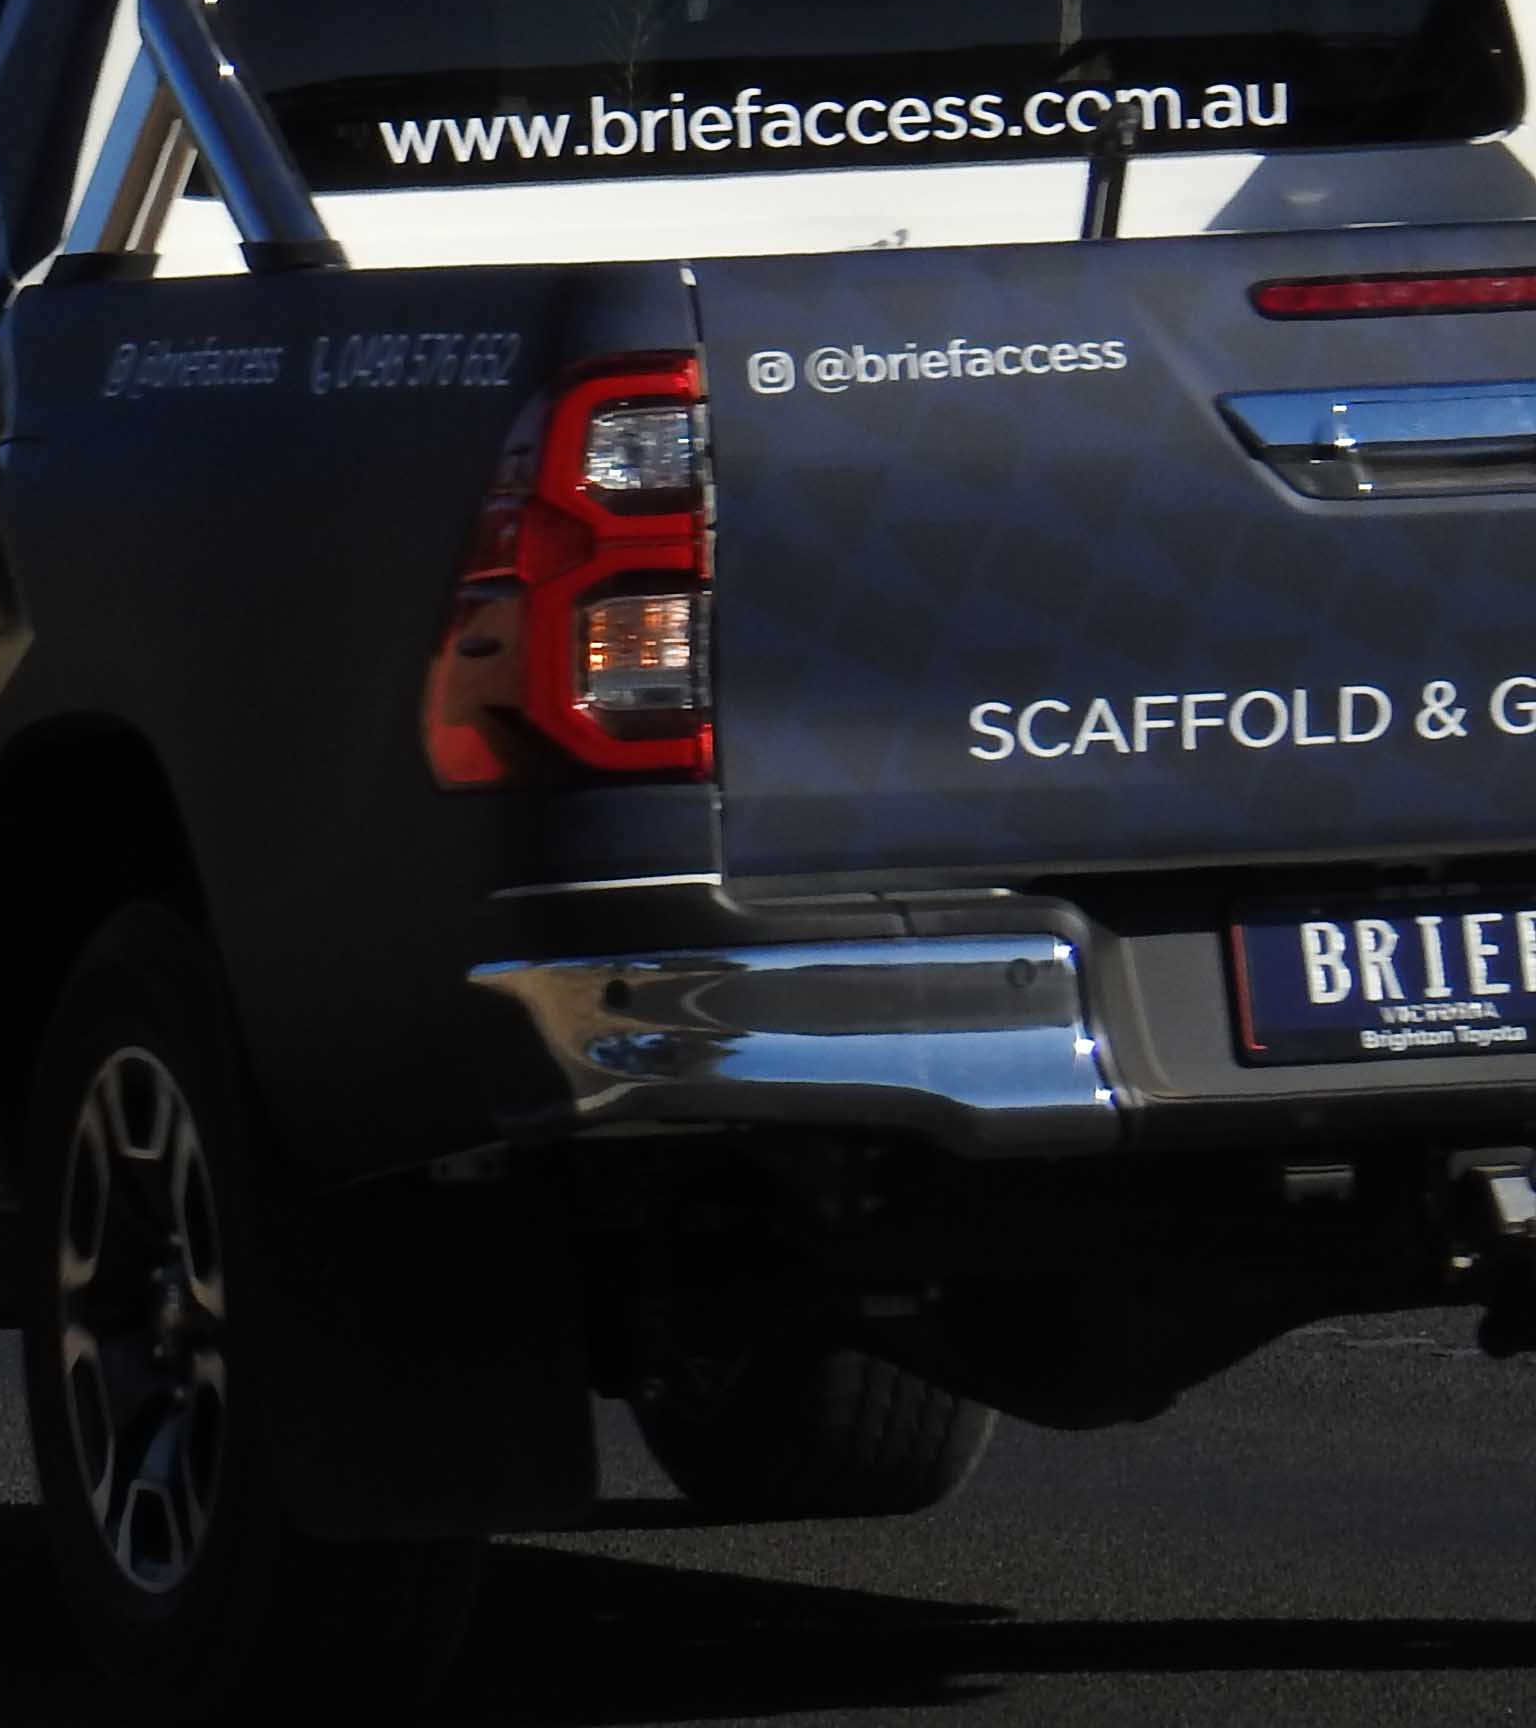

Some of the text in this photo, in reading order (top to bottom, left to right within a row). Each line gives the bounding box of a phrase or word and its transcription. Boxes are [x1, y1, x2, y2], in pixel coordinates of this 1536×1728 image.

[379, 81, 1288, 165] www.briefaccess.com.au
[804, 338, 1128, 393] @briefaccess
[968, 685, 1393, 761] SCAFFOLD
[1414, 680, 1469, 741] &
[1359, 1024, 1528, 1052] Brighton Toyota
